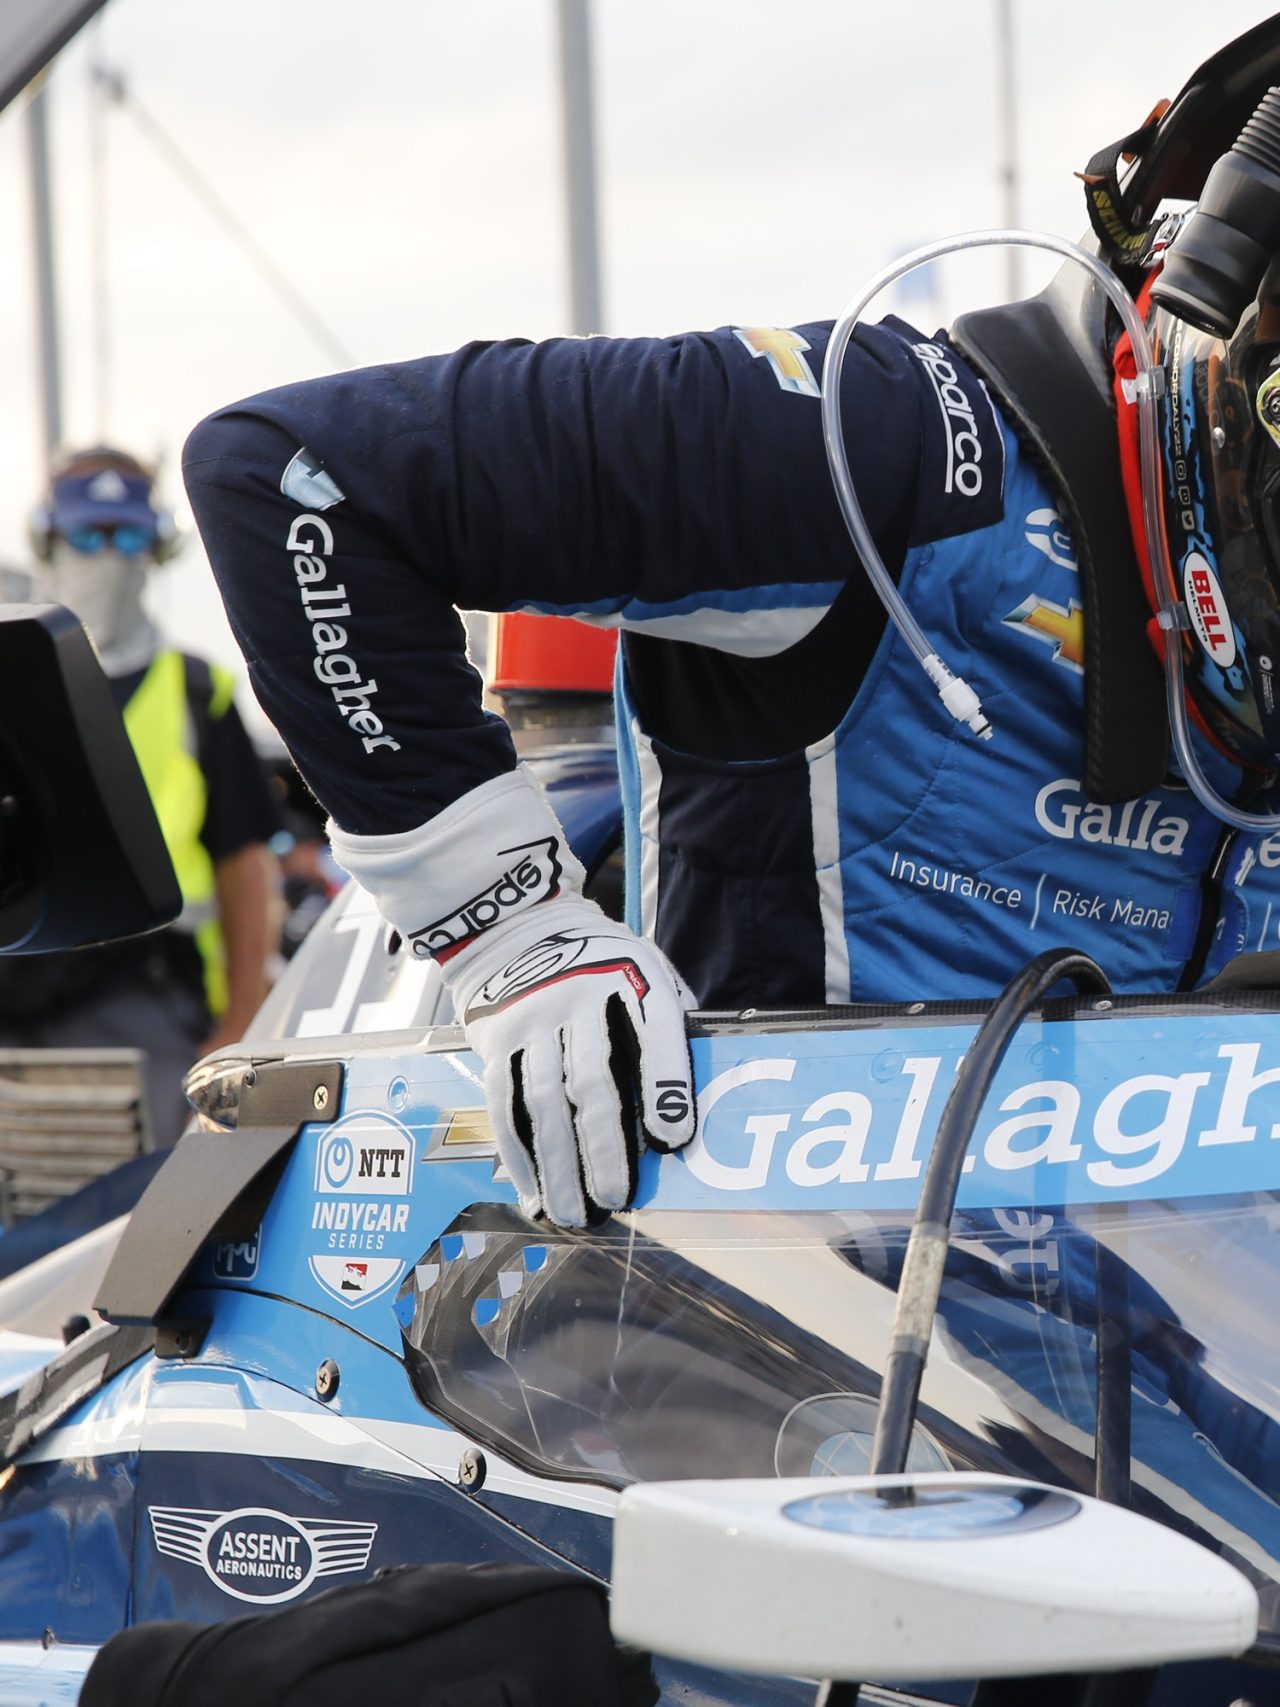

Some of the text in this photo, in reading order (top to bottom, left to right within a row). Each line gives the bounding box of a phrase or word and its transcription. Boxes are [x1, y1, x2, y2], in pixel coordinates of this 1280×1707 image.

[1191, 570, 1227, 652] BELL
[286, 513, 401, 755] Gallagher
[889, 851, 1022, 909] Insurance
[1051, 889, 1107, 922] Risk
[358, 1148, 405, 1178] NTT
[311, 1201, 410, 1232] INDYCAR
[328, 1233, 385, 1250] SERIES
[219, 1531, 301, 1563] ASSENT
[215, 1559, 302, 1580] AERONAUTICS
